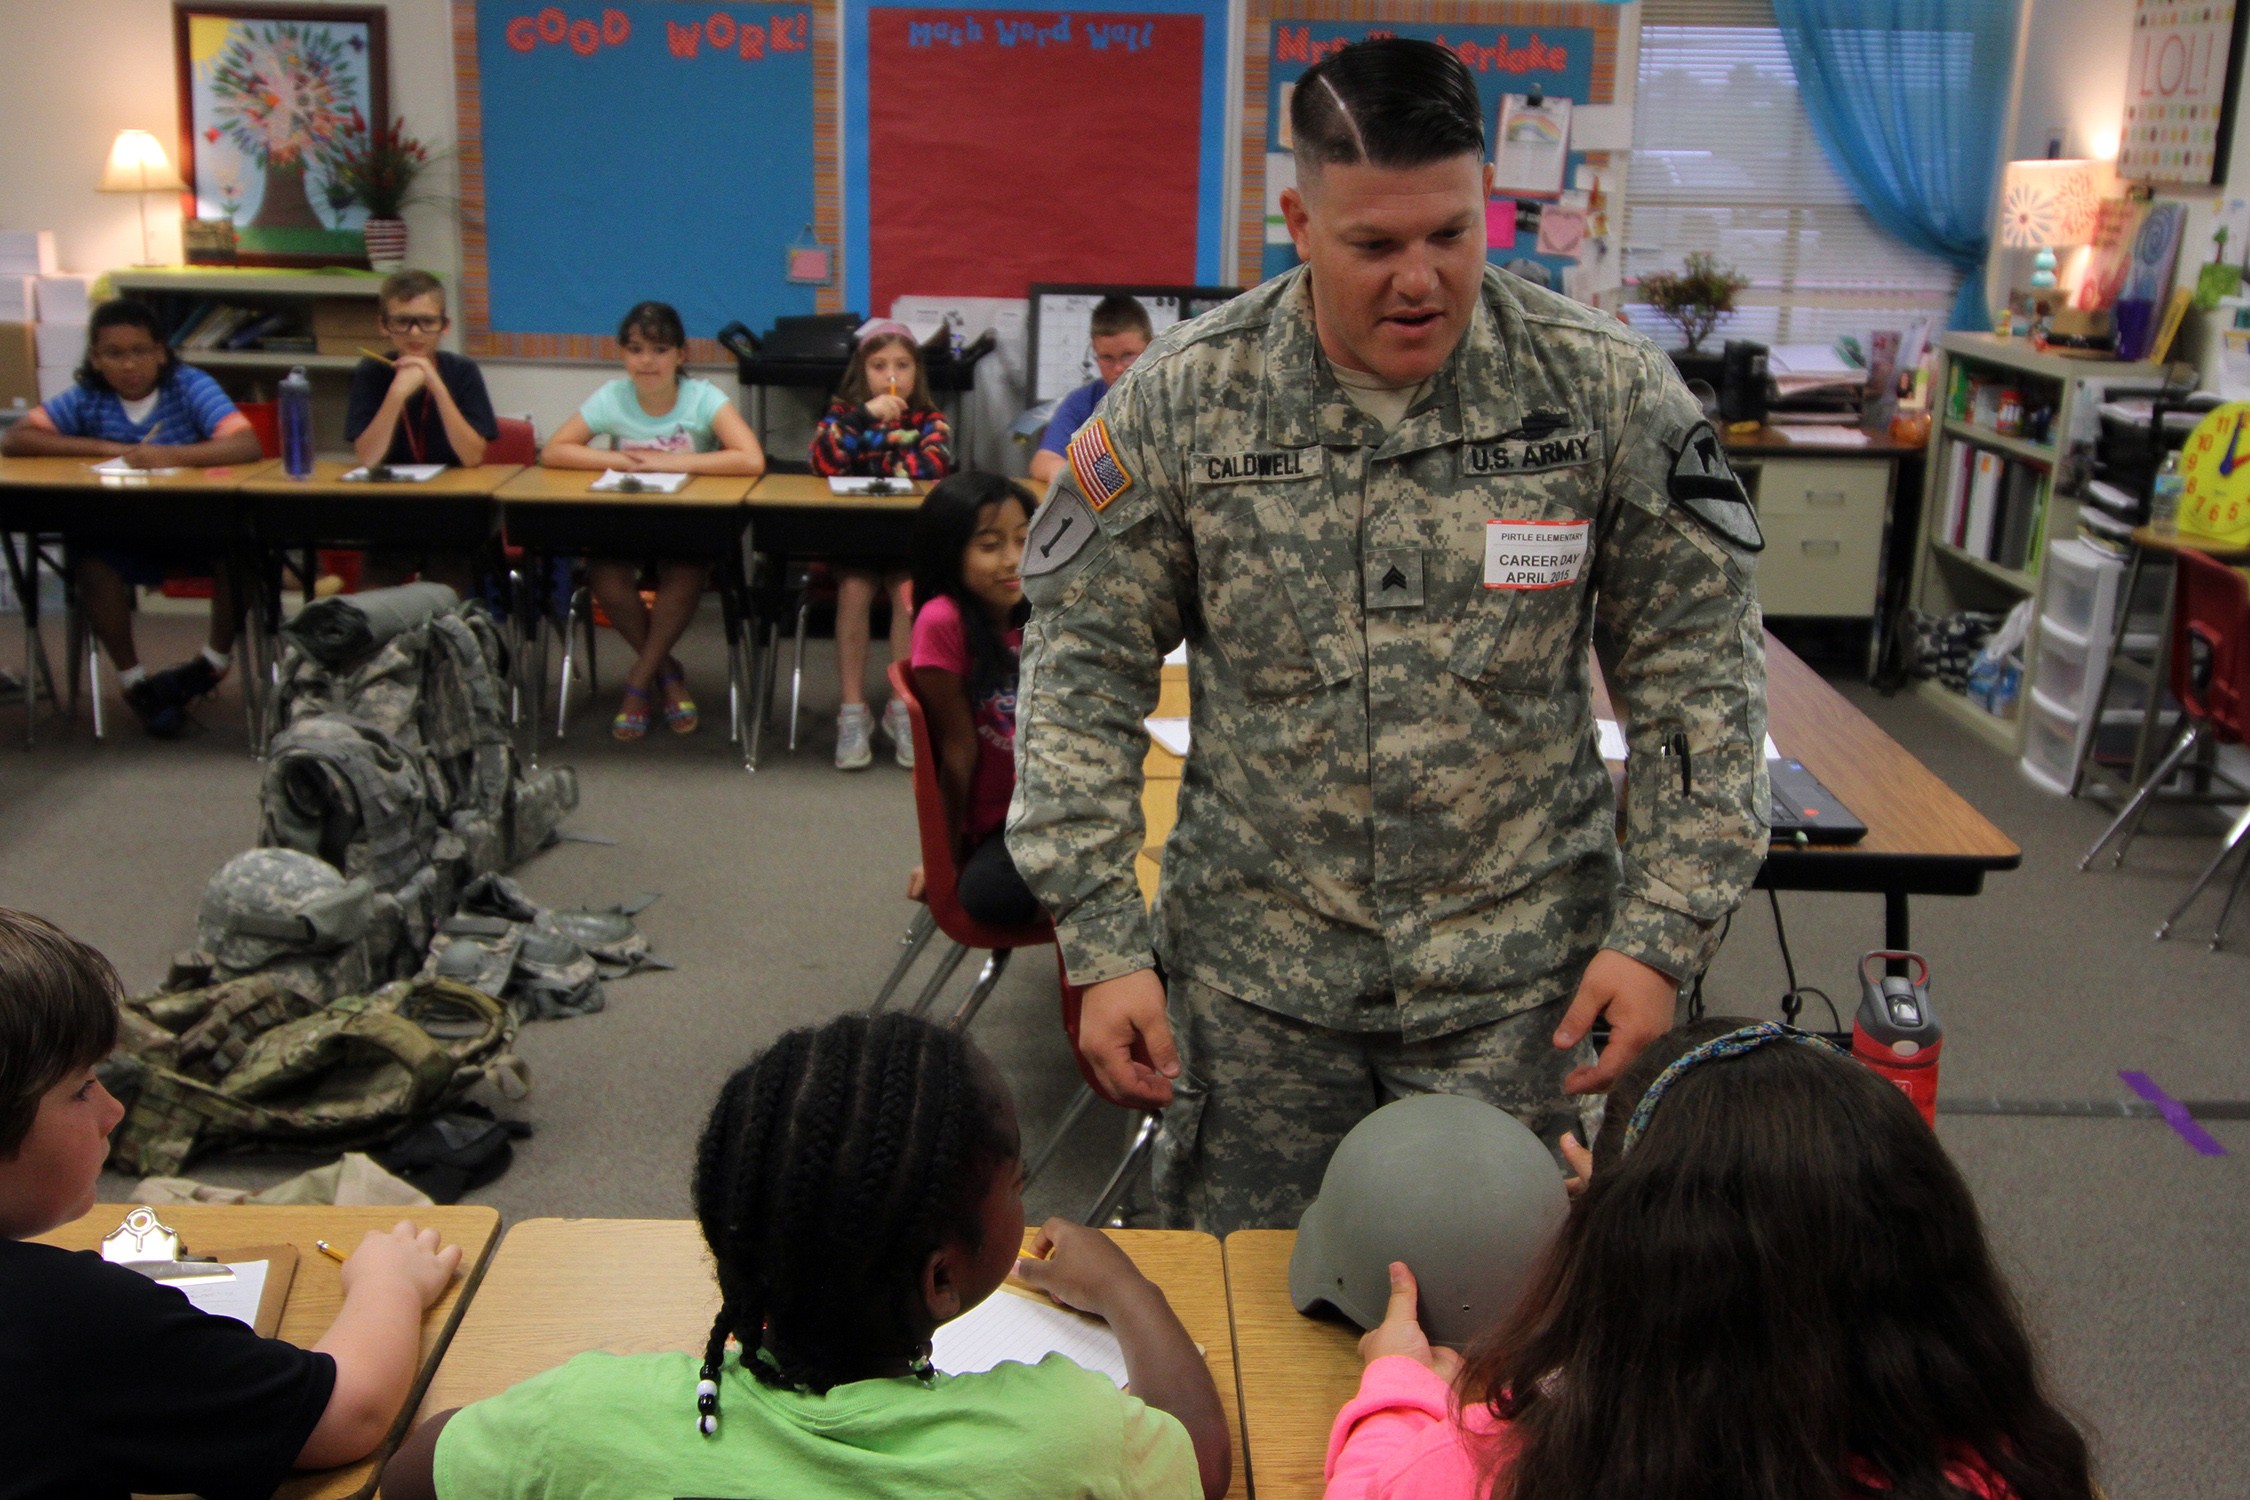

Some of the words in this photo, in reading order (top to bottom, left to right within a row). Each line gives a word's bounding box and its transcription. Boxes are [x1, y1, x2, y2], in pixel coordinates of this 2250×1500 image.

[505, 7, 632, 56] GOOD
[666, 12, 808, 60] WORK!
[908, 15, 983, 47] Math
[994, 14, 1071, 47] Word
[1086, 21, 1153, 51] Wall
[2140, 33, 2213, 97] LOL!
[1471, 447, 1515, 471] U.S.
[1521, 436, 1590, 468] ARMY
[2198, 434, 2213, 451] 10
[1208, 453, 1304, 479] CALDWELL
[1501, 532, 1534, 542] PIRTLE
[1536, 532, 1584, 542] ELEMENTARY
[1499, 554, 1559, 567] CAREER
[1560, 553, 1580, 566] DAY
[1506, 572, 1548, 584] APRIL
[1550, 570, 1570, 583] 2015
